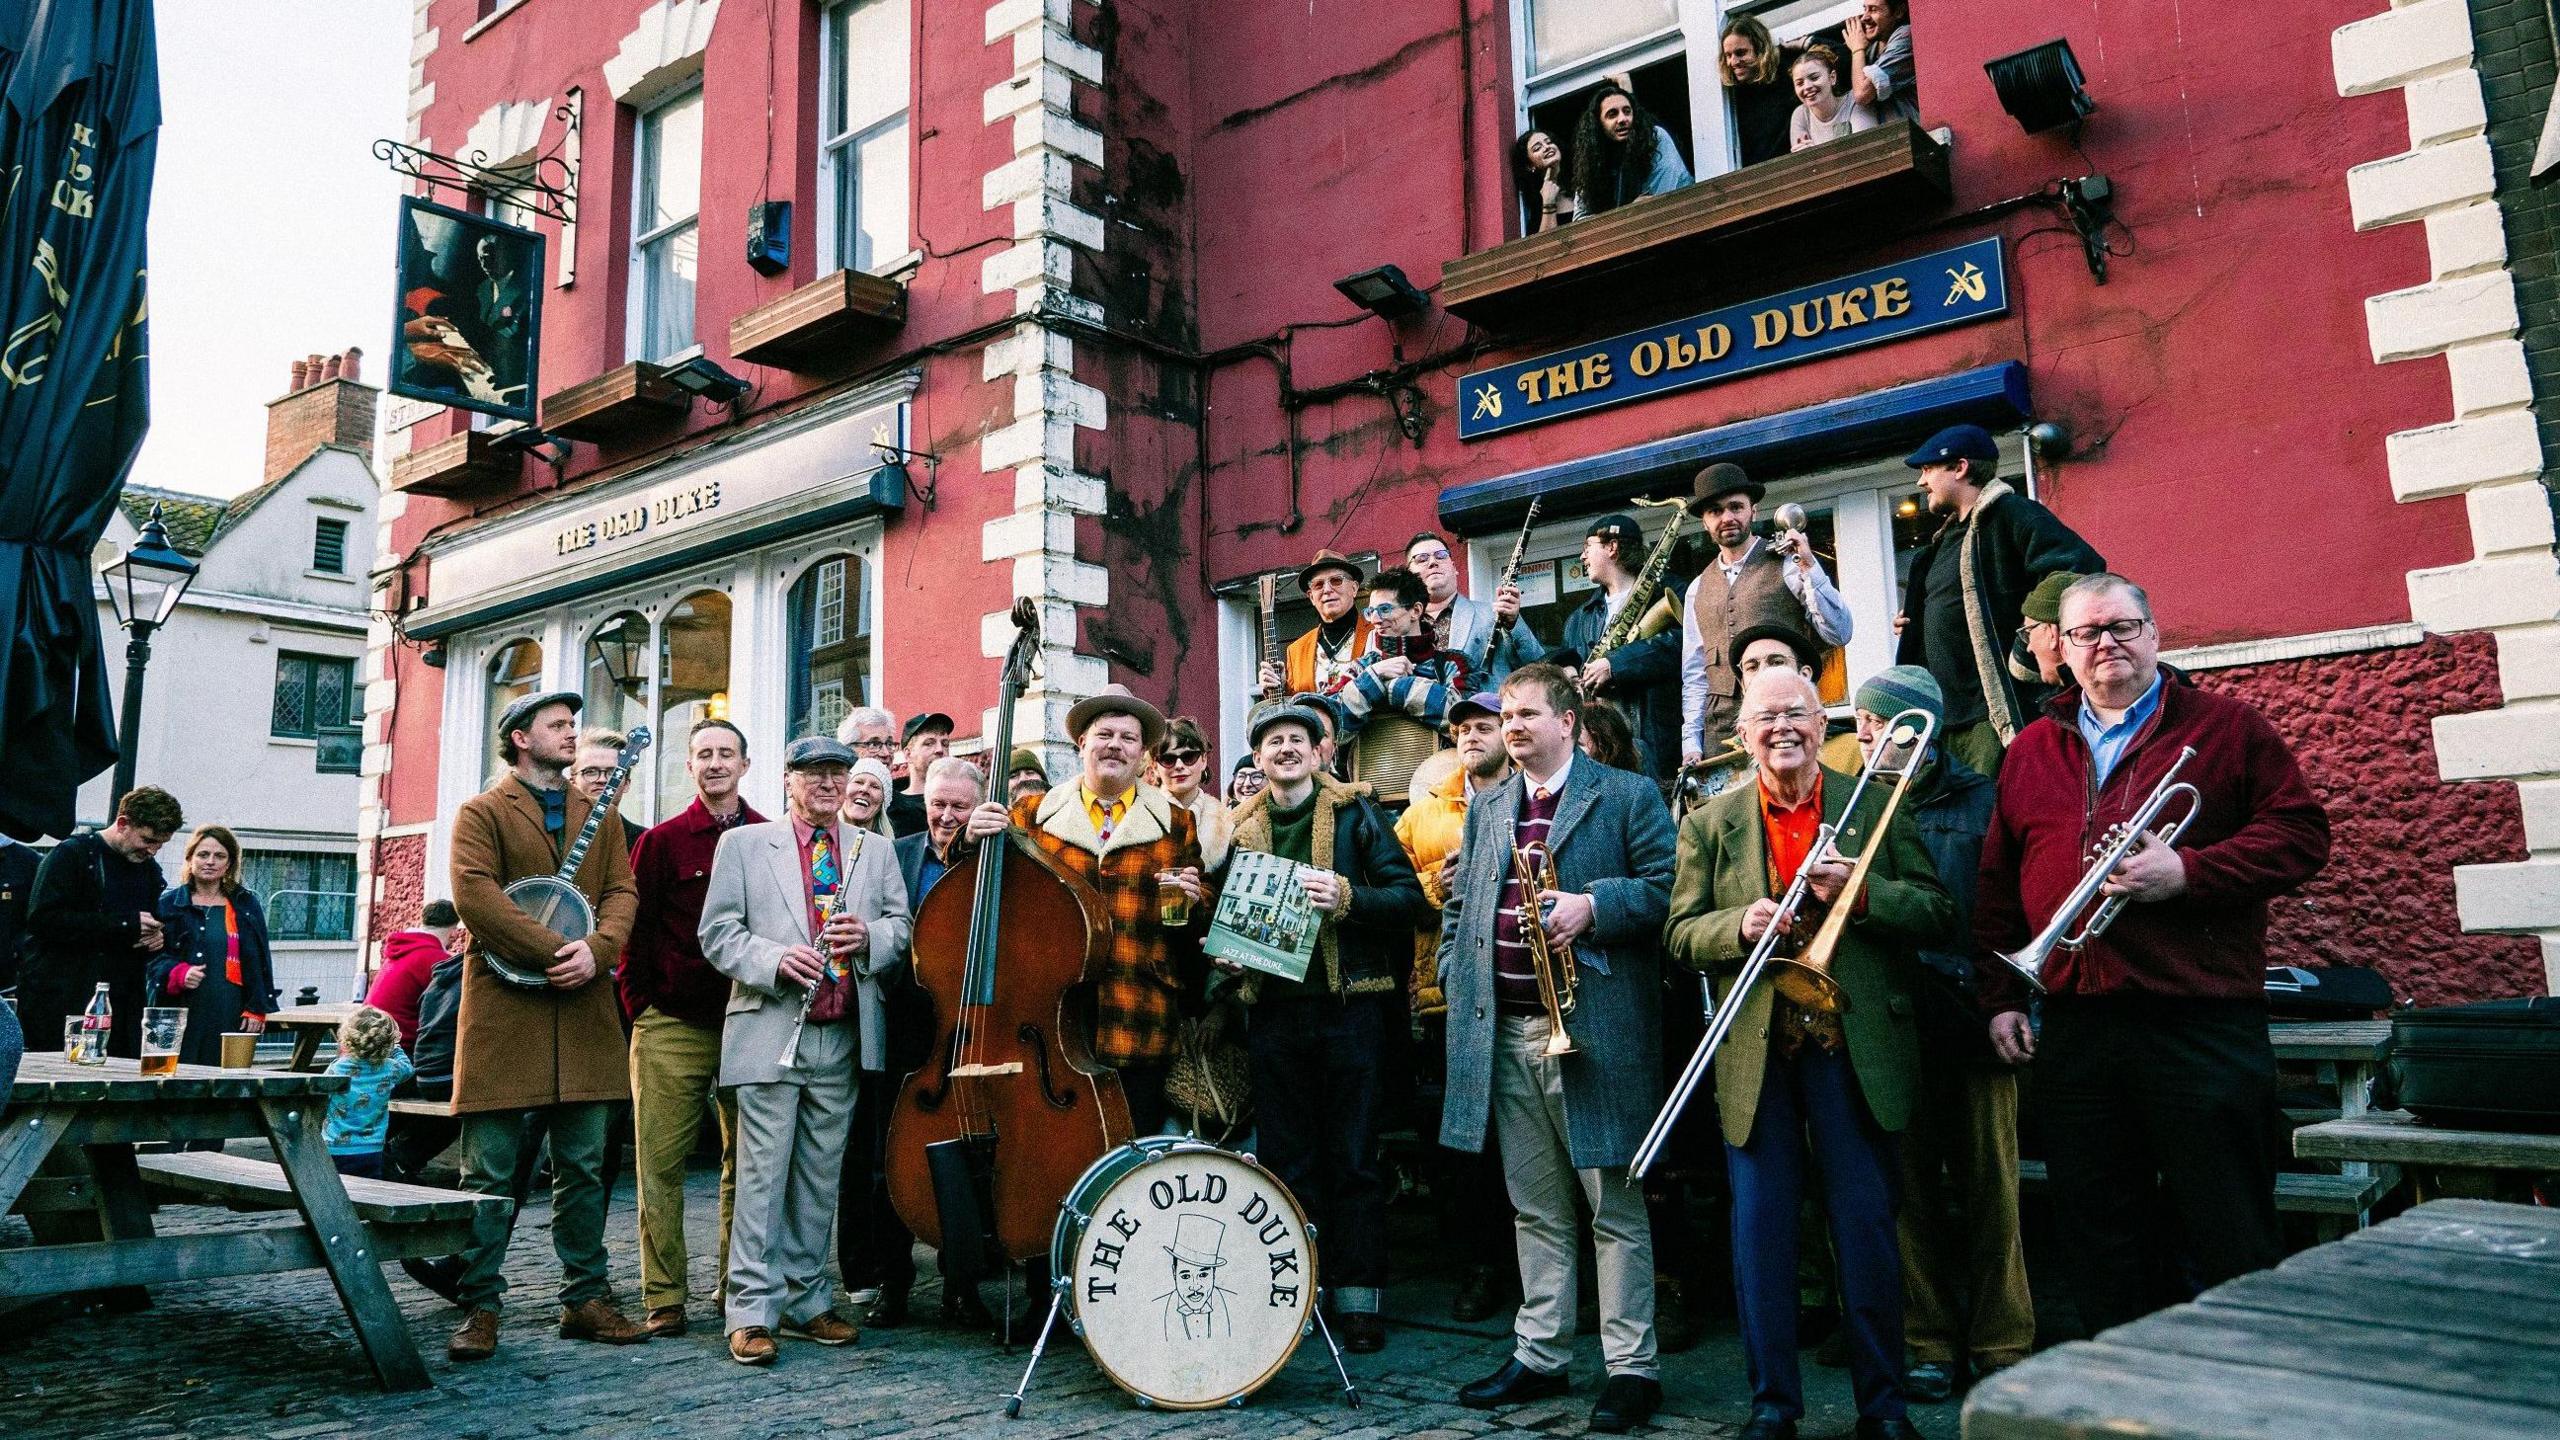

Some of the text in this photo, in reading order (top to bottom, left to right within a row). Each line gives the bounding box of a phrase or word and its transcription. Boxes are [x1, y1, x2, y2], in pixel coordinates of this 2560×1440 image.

[1517, 277, 1912, 404] THE OLD DUKE
[554, 481, 721, 556] THE OLD DUKE
[1221, 946, 1284, 971] JAZZ AT THE DUKE
[1088, 1172, 1300, 1308] THE OLD DUKE
